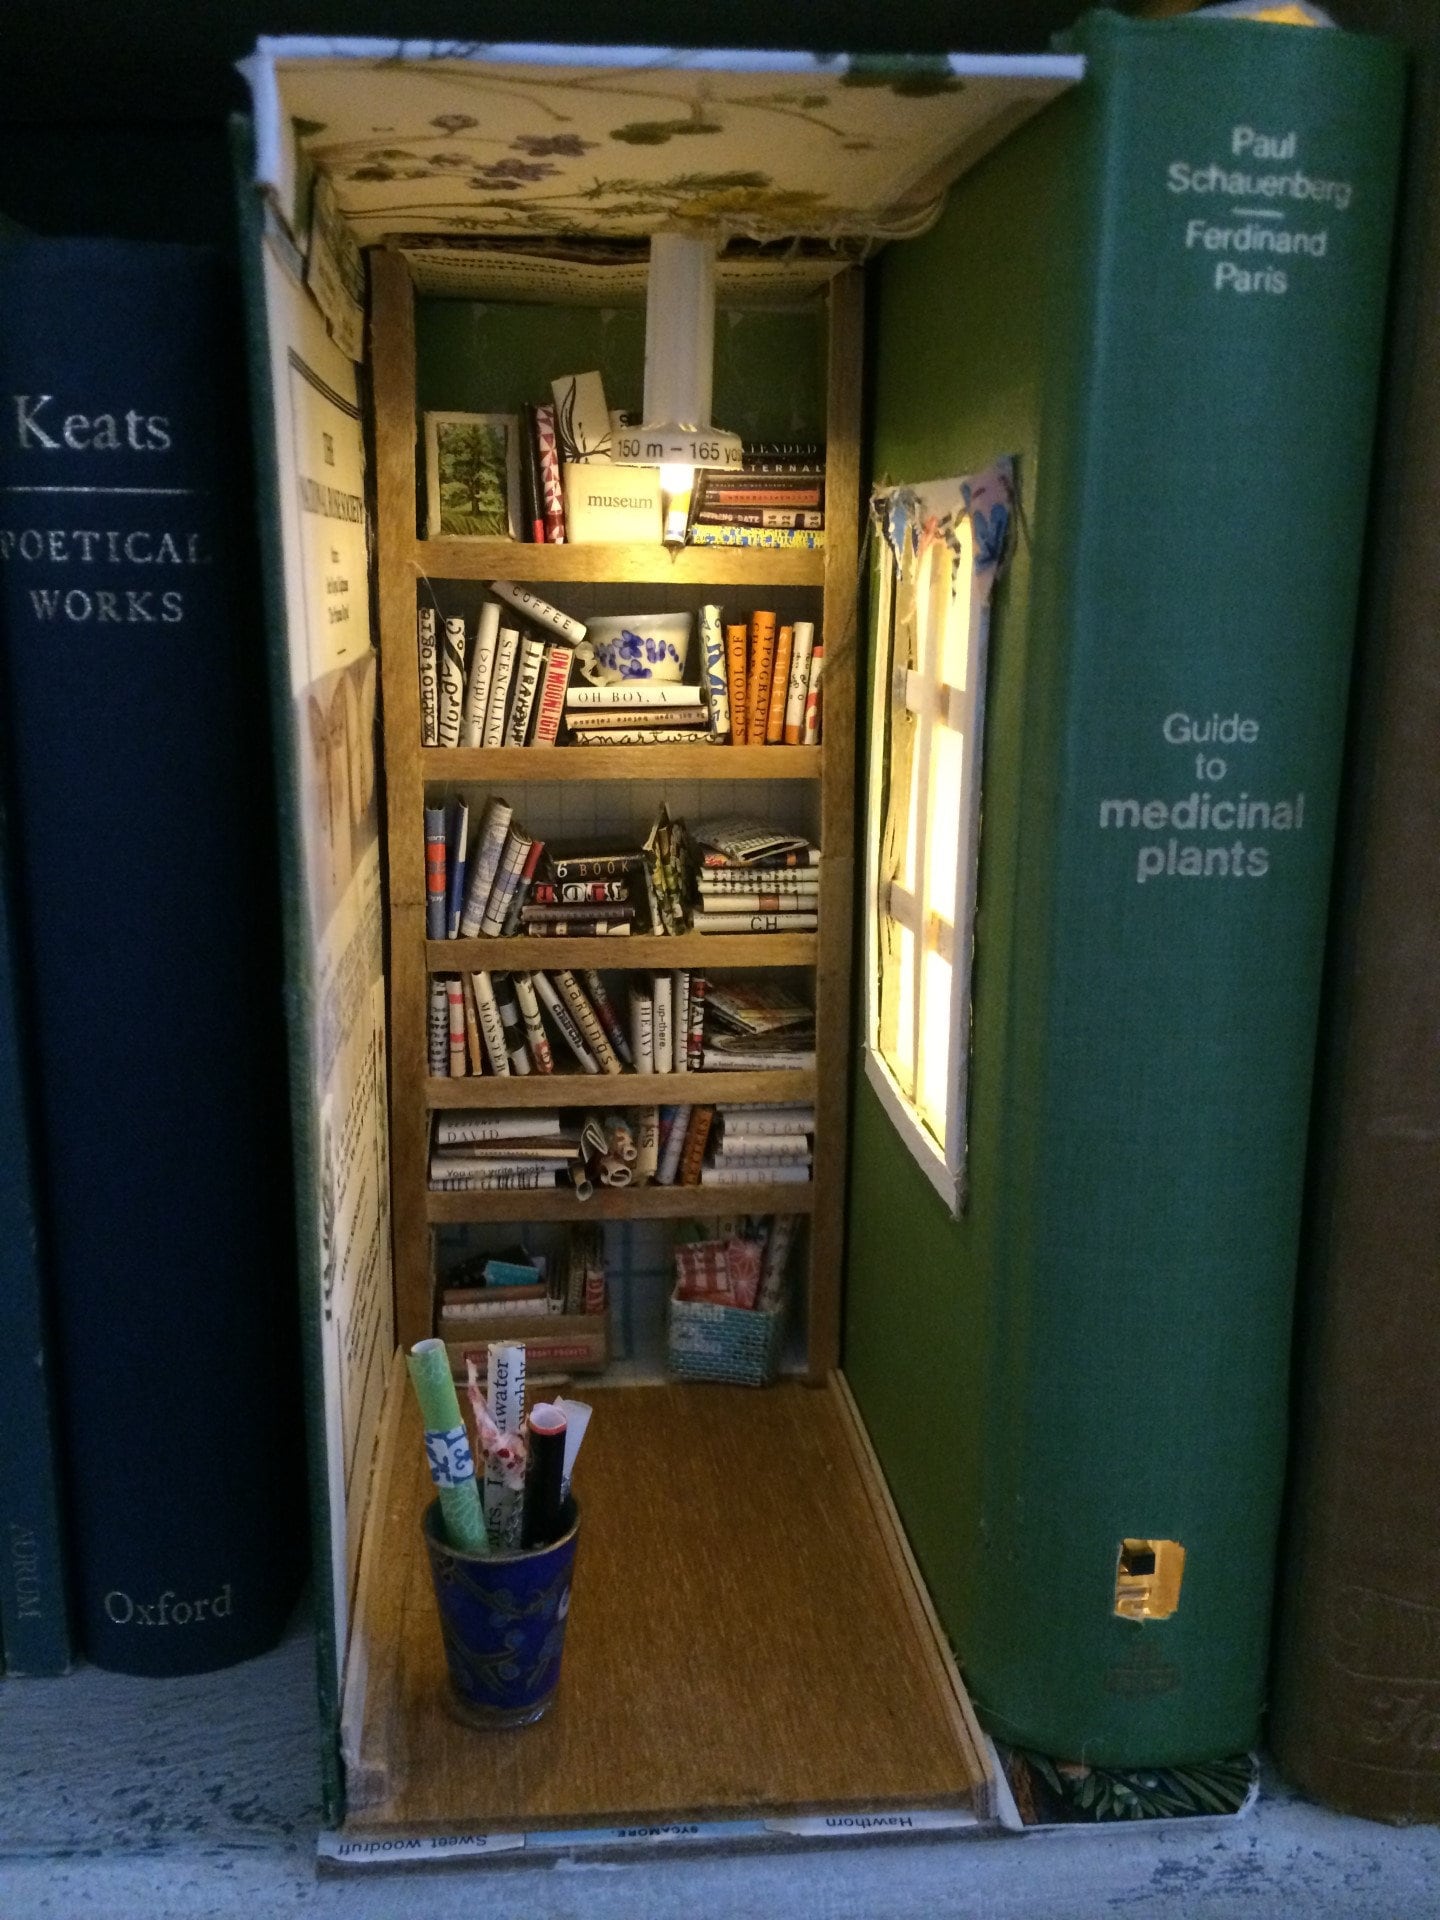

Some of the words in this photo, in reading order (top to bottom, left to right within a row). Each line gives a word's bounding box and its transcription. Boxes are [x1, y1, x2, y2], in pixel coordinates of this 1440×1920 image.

[1231, 124, 1296, 159] Paul
[1167, 161, 1353, 210] Schauenberg
[1185, 219, 1328, 257] Ferdinand
[1214, 261, 1288, 294] Paris
[14, 396, 172, 450] Keats
[618, 438, 641, 457] 150
[646, 443, 663, 459] m
[690, 442, 720, 462] 165
[587, 494, 653, 509] museum
[30, 590, 183, 622] WORKS
[512, 586, 572, 630] COFFEE
[552, 650, 571, 669] ON
[732, 635, 744, 659] OF
[487, 639, 513, 747] STENCILING
[773, 633, 788, 724] STUDENT
[537, 671, 566, 744] MOONLIGHT
[577, 691, 601, 704] OH
[660, 690, 668, 703] A
[732, 665, 746, 738] SCHOOL
[1163, 712, 1260, 744] Guide
[1195, 752, 1228, 781] to
[1100, 791, 1305, 830] medicinal
[557, 862, 568, 878] 6
[579, 861, 631, 878] BOOK
[1137, 837, 1269, 883] plants
[479, 1001, 507, 1073] MONSTER
[640, 1006, 653, 1059] HEAVY
[657, 1004, 670, 1051] up-there.
[446, 1128, 500, 1142] DAVID
[9, 1523, 42, 1619] AURUM
[104, 1584, 232, 1625] Oxford
[433, 1834, 488, 1848] Sweet
[826, 1816, 914, 1830] Hawthorn
[338, 1841, 421, 1856] woodruff
